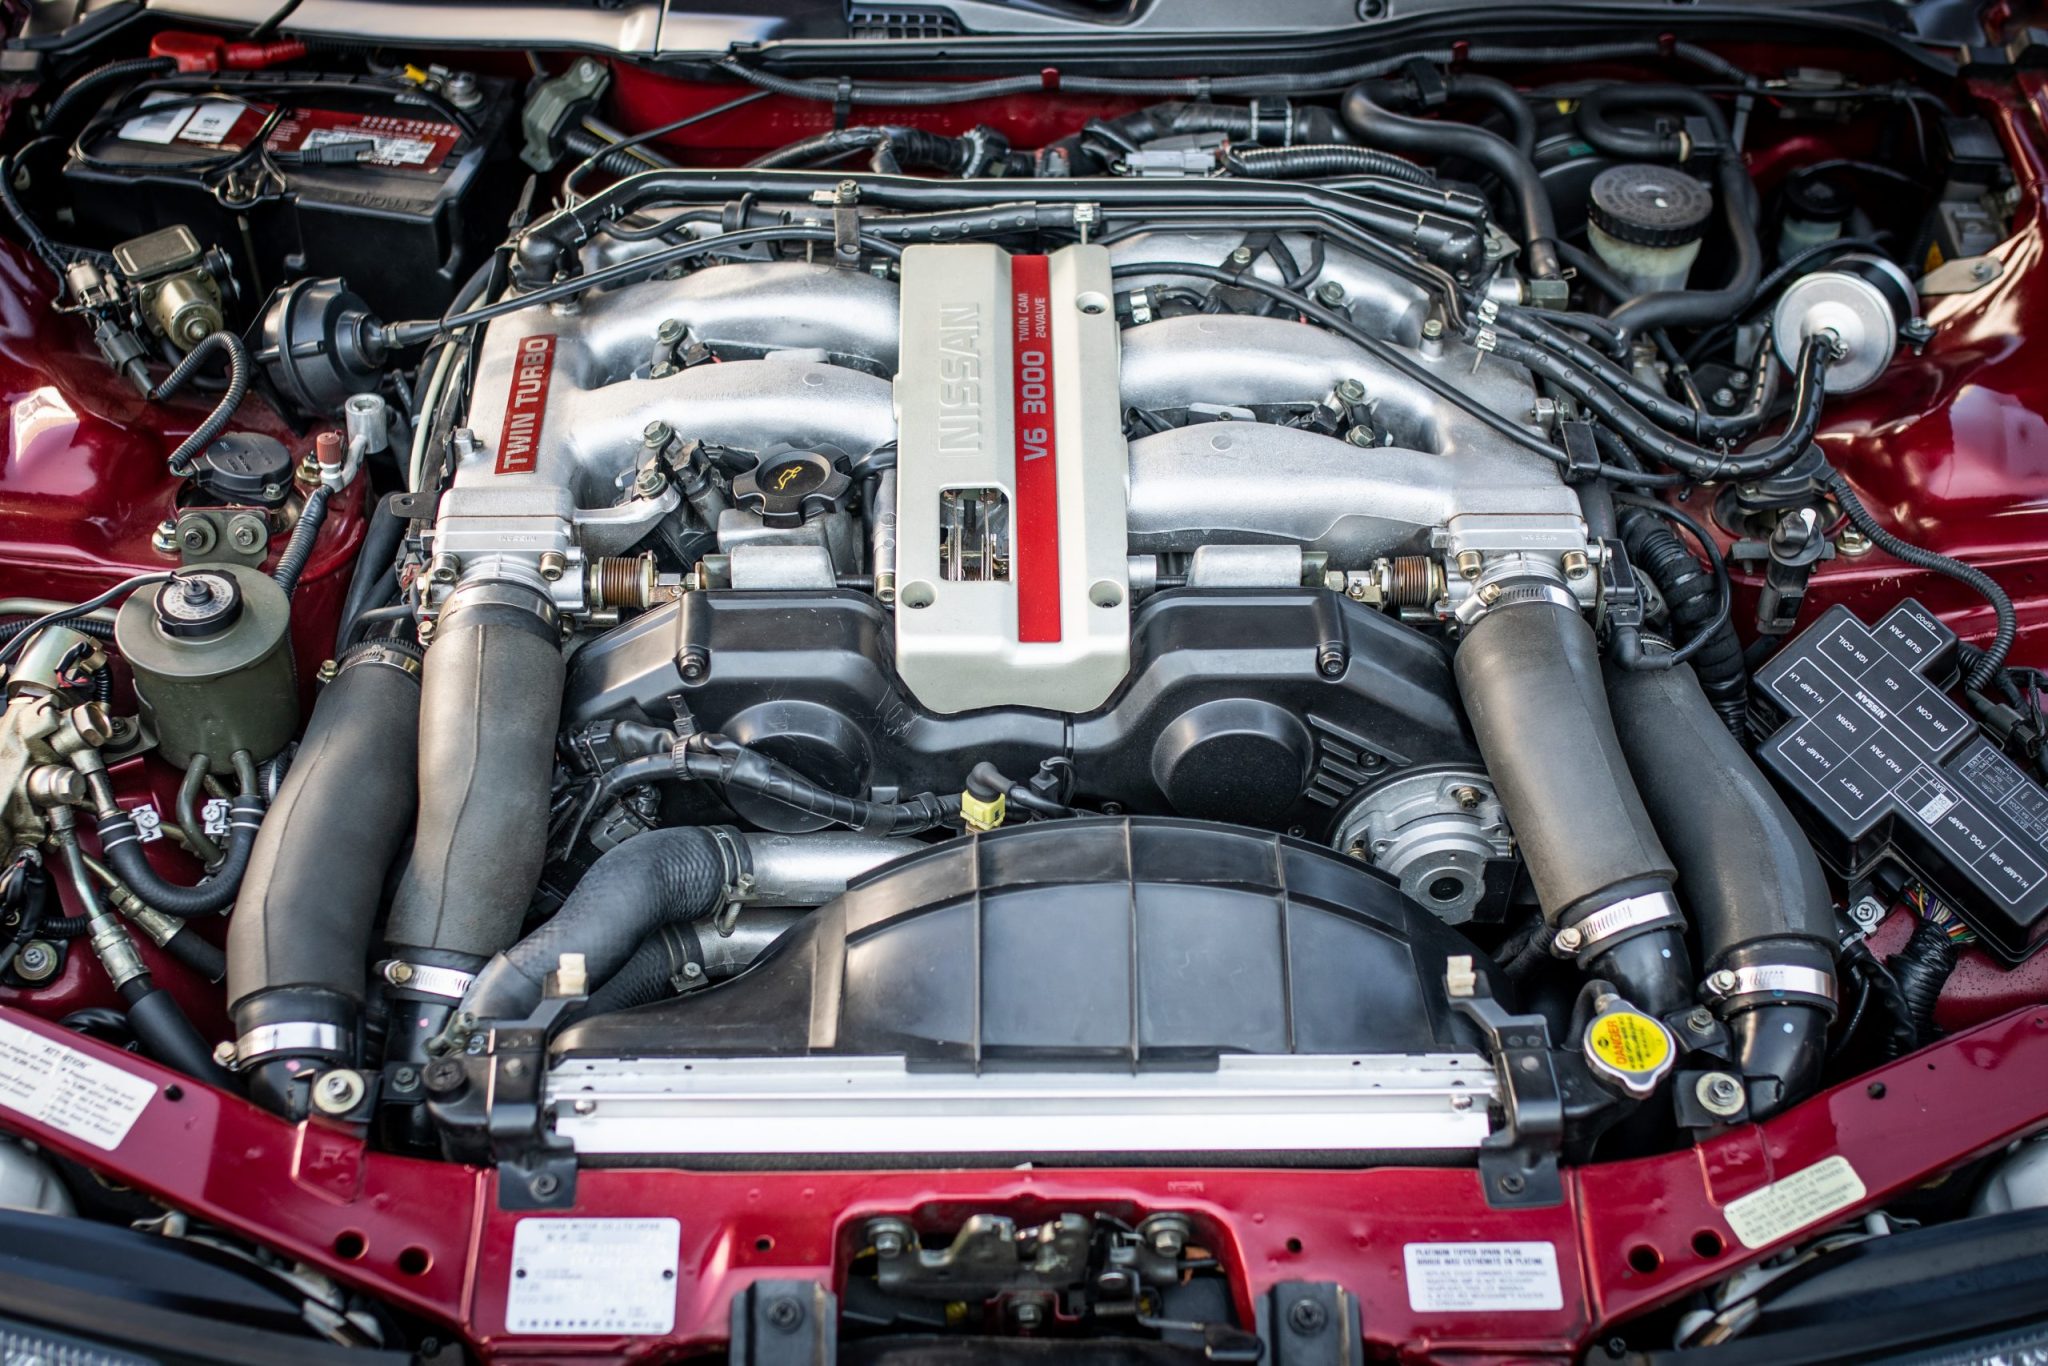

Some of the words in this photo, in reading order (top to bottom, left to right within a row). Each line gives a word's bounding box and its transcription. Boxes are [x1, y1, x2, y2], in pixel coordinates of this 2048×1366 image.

[1018, 292, 1029, 314] CAM
[1035, 297, 1046, 338] 24VALVE
[1019, 317, 1030, 342] TWIN
[515, 338, 549, 408] TURBO
[938, 302, 980, 452] NISSAN
[1021, 350, 1046, 414] 3000
[503, 413, 536, 469] TWIN
[1023, 427, 1048, 462] V6
[1888, 624, 1906, 639] FAN
[1838, 635, 1854, 651] COIL
[1905, 638, 1922, 654] SUB
[1854, 651, 1869, 664] IGN
[1789, 672, 1801, 682] LH
[1884, 677, 1899, 691] EGI
[1800, 683, 1825, 704] H/LAMP
[1855, 691, 1887, 720] NISSAN
[1916, 705, 1933, 720] CON
[1836, 714, 1857, 733] HORN
[1933, 720, 1949, 733] AIR
[1795, 736, 1807, 747] RH
[1806, 747, 1831, 769] H/LAMP
[1869, 744, 1886, 759] FAN
[1885, 758, 1902, 774] RAD
[1840, 777, 1865, 800] THEFT
[1928, 778, 1948, 794] BATT
[1948, 816, 1970, 835] LAMP
[1970, 834, 1987, 850] FOG
[1989, 852, 2004, 865] DIM
[2003, 866, 2029, 888] H/LAMP
[1606, 1020, 1627, 1065] DANGER
